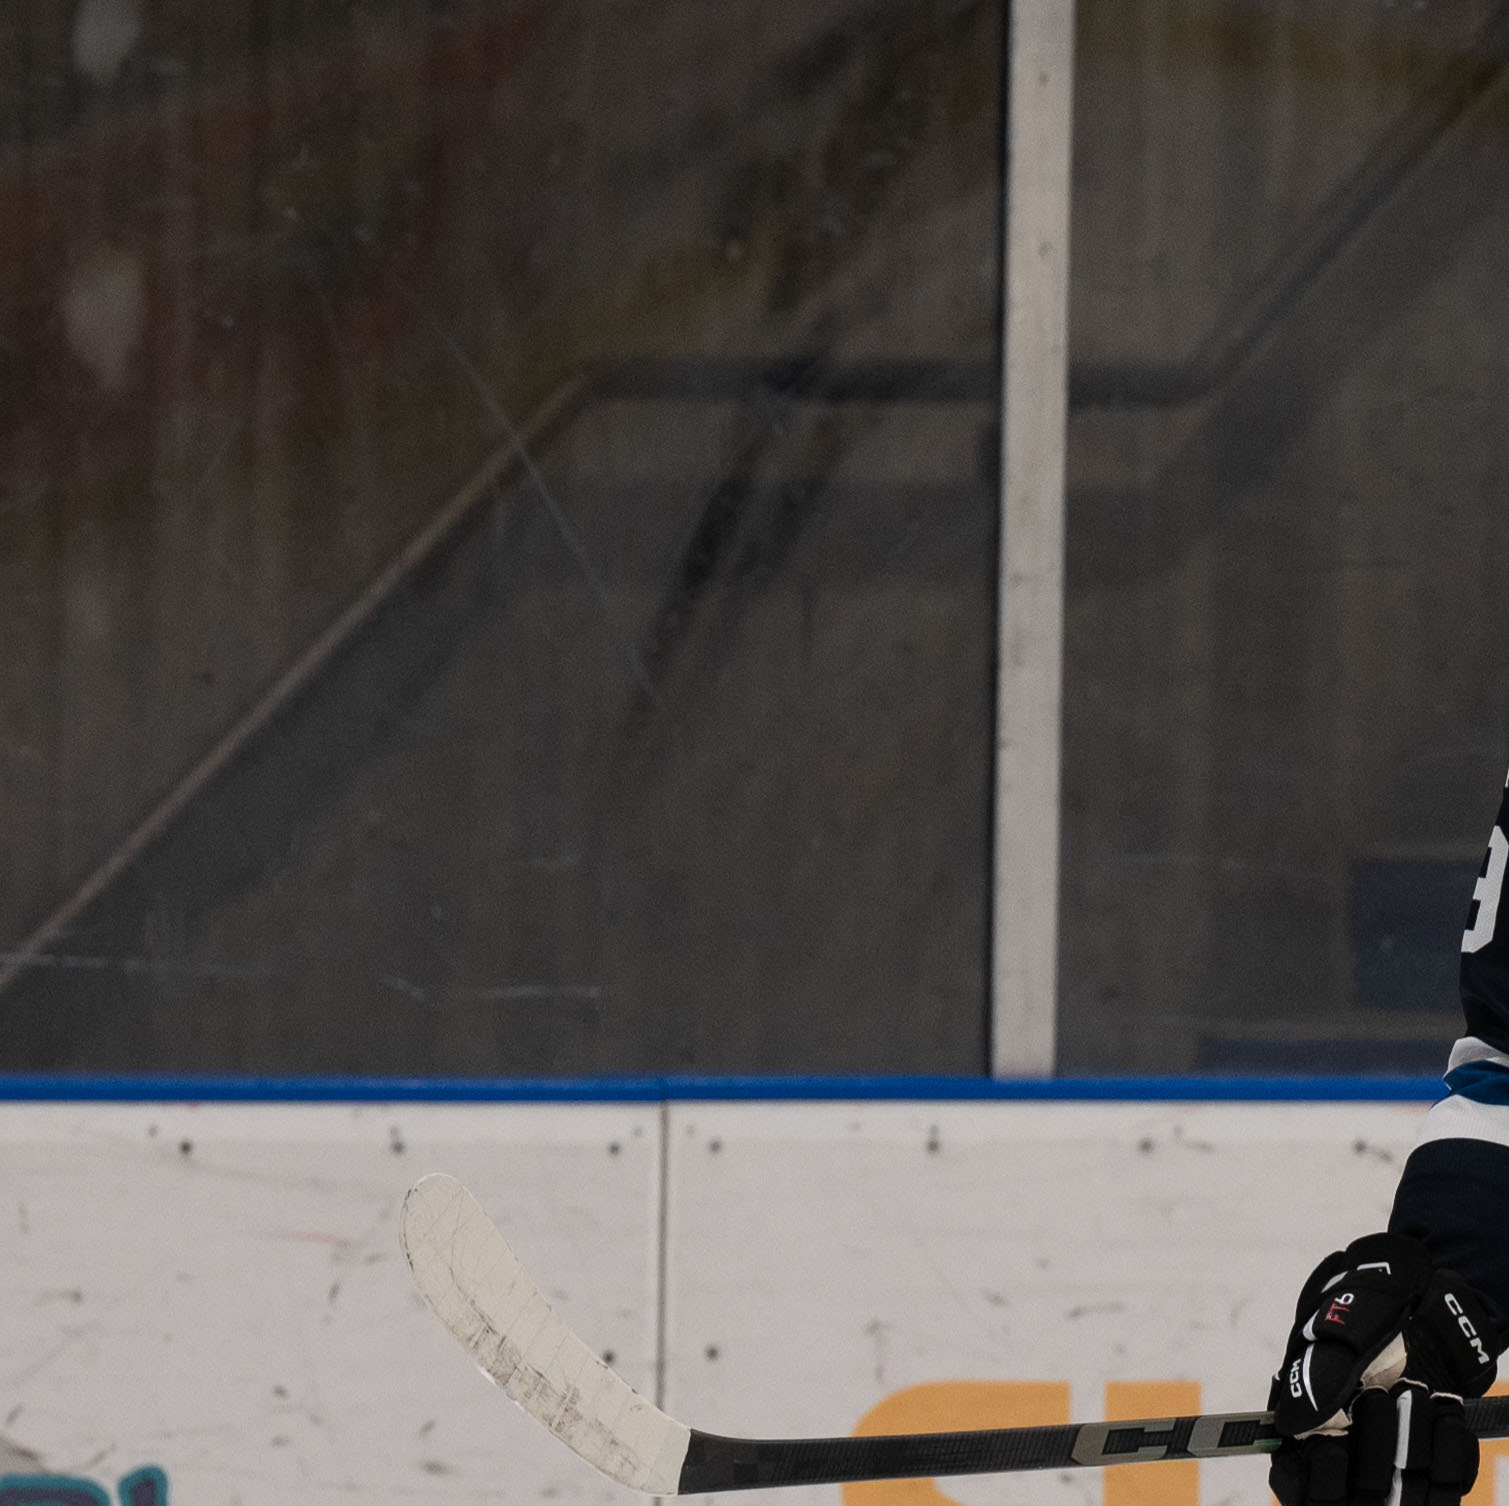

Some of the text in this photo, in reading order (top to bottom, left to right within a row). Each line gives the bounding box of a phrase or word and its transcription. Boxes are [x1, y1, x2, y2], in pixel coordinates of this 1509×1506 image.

[1444, 1293, 1490, 1364] CCM
[1290, 1359, 1302, 1398] CCM
[1071, 1411, 1284, 1466] CC
